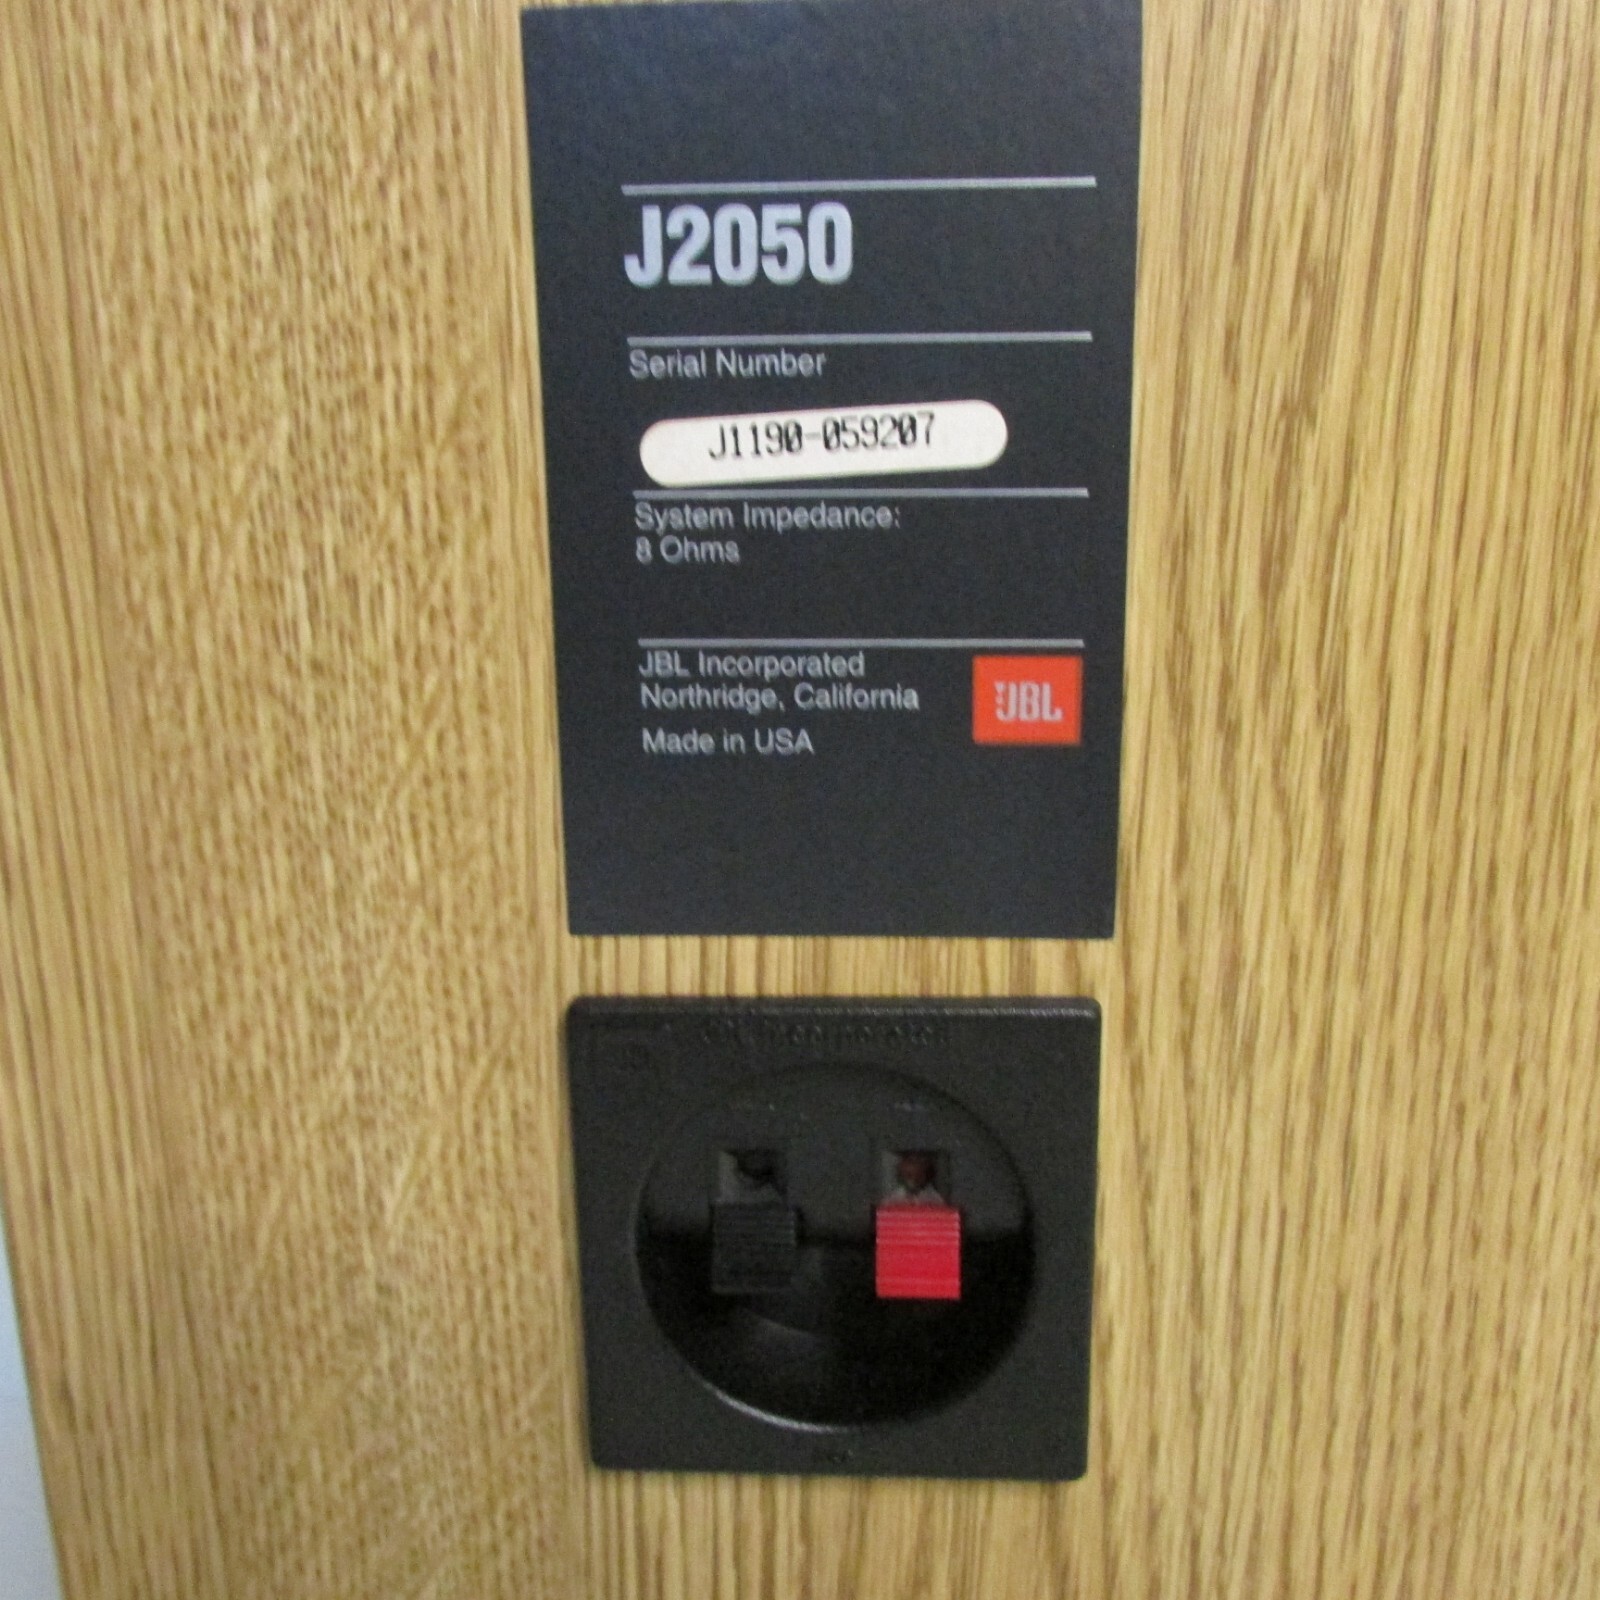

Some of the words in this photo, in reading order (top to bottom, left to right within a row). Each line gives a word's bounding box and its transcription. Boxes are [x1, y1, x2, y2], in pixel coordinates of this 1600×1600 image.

[624, 202, 853, 287] J2050
[629, 348, 706, 379] Serial
[716, 346, 825, 376] Number
[709, 411, 936, 459] J1190-059207
[634, 502, 734, 535] System
[744, 501, 901, 533] Impedance:
[635, 537, 652, 564] 8
[660, 536, 740, 564] Ohms
[639, 651, 690, 678] JBL
[699, 650, 865, 681] Incorporated
[641, 682, 785, 714] Northridge,
[793, 681, 920, 711] California
[995, 681, 1063, 722] JBL
[642, 727, 715, 755] Made
[724, 727, 746, 753] in
[755, 727, 815, 755] USA
